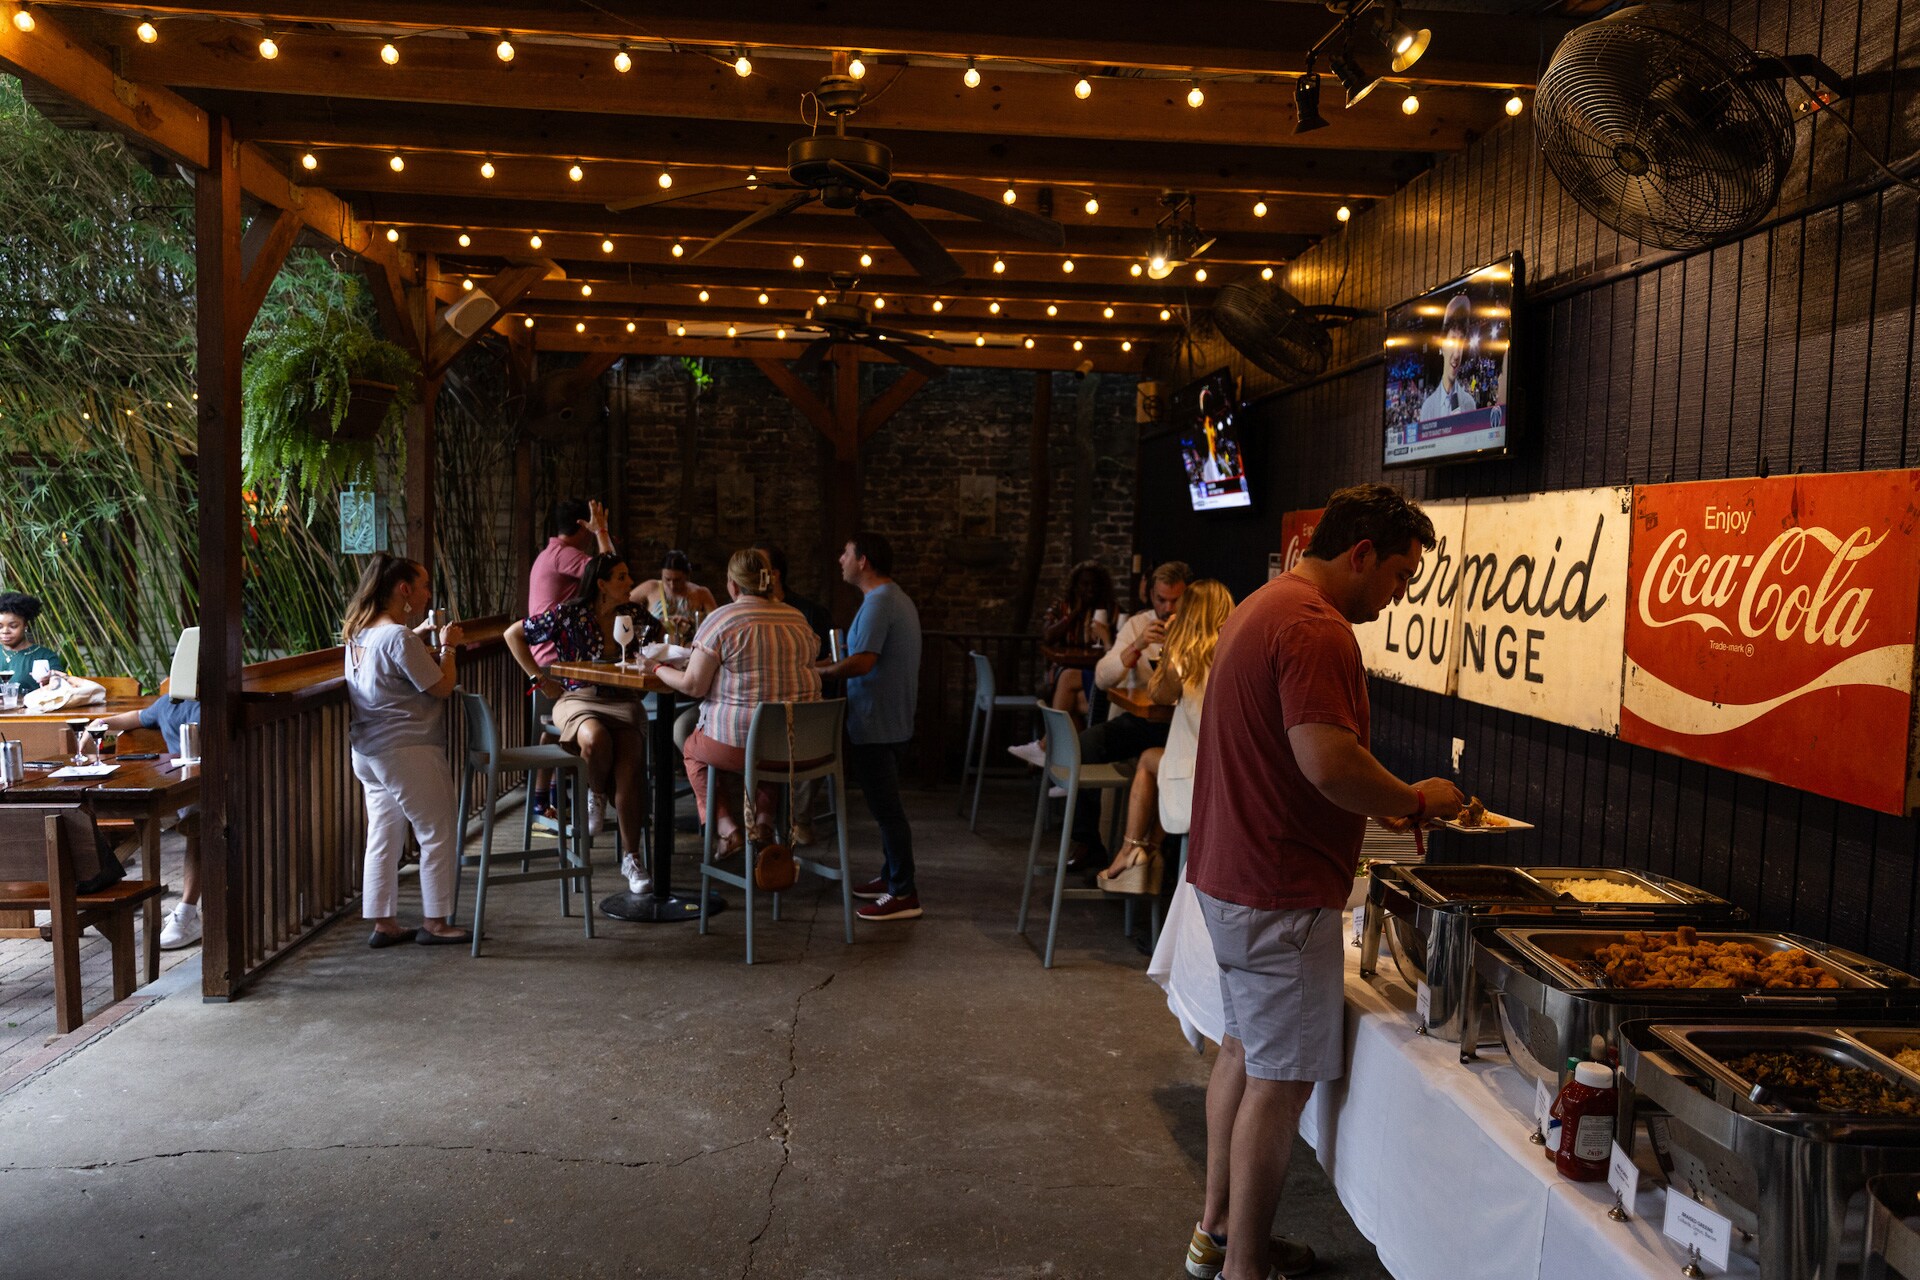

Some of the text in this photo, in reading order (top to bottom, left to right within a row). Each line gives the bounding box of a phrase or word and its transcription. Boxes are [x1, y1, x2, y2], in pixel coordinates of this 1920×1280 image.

[1705, 506, 1751, 534] Enjoy
[1393, 513, 1608, 622] ermaid
[1638, 525, 1893, 648] Coca-Cola
[1385, 611, 1546, 684] LOUNGE
